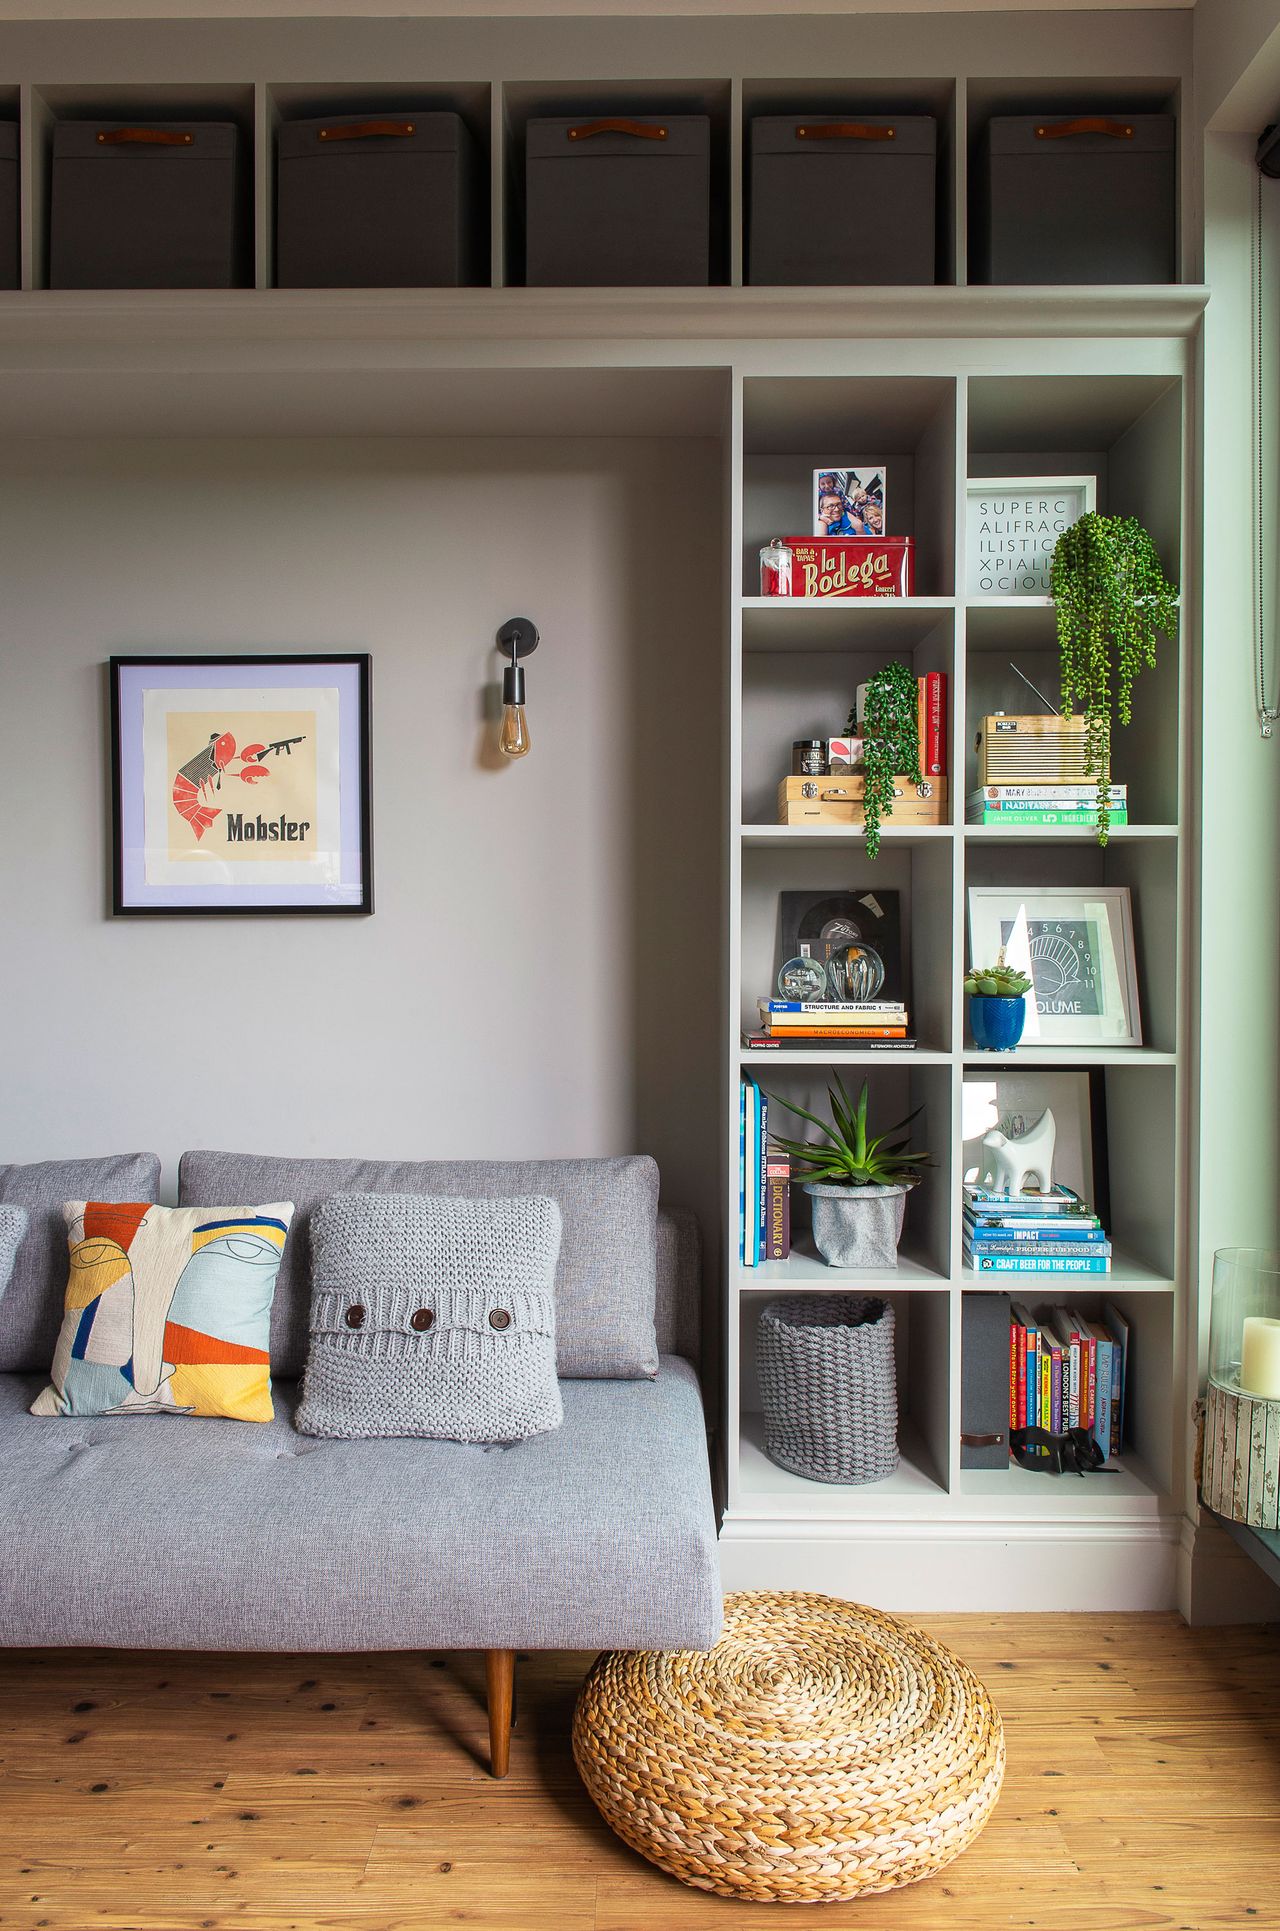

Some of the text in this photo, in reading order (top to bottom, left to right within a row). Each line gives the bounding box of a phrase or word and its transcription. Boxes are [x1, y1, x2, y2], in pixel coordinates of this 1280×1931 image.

[980, 501, 1065, 515] SUPERC
[980, 520, 1065, 533] ALIFRAG
[980, 539, 1053, 552] ILISTIC
[821, 549, 836, 573] la
[980, 558, 1048, 571] XPIALI
[802, 551, 890, 597] Bodega
[980, 577, 1052, 590] OCIOU
[1005, 788, 1025, 796] MARY
[1043, 814, 1057, 823] 5
[1061, 814, 1098, 823] INGREDIENT
[226, 813, 310, 842] Mobster
[1028, 927, 1034, 936] 4
[1042, 924, 1048, 932] 5
[1055, 924, 1062, 933] 6
[1069, 931, 1075, 939] 7
[1078, 940, 1084, 949] 8
[1084, 953, 1090, 962] 9
[1086, 967, 1097, 975] 10
[1084, 980, 1094, 988] 11
[1036, 1001, 1081, 1014] OLUME
[773, 1185, 783, 1245] DICTIONARY
[1013, 1231, 1039, 1240] IMPACT
[996, 1259, 1091, 1270] CRAFT BEER FOR THE PEOPLE
